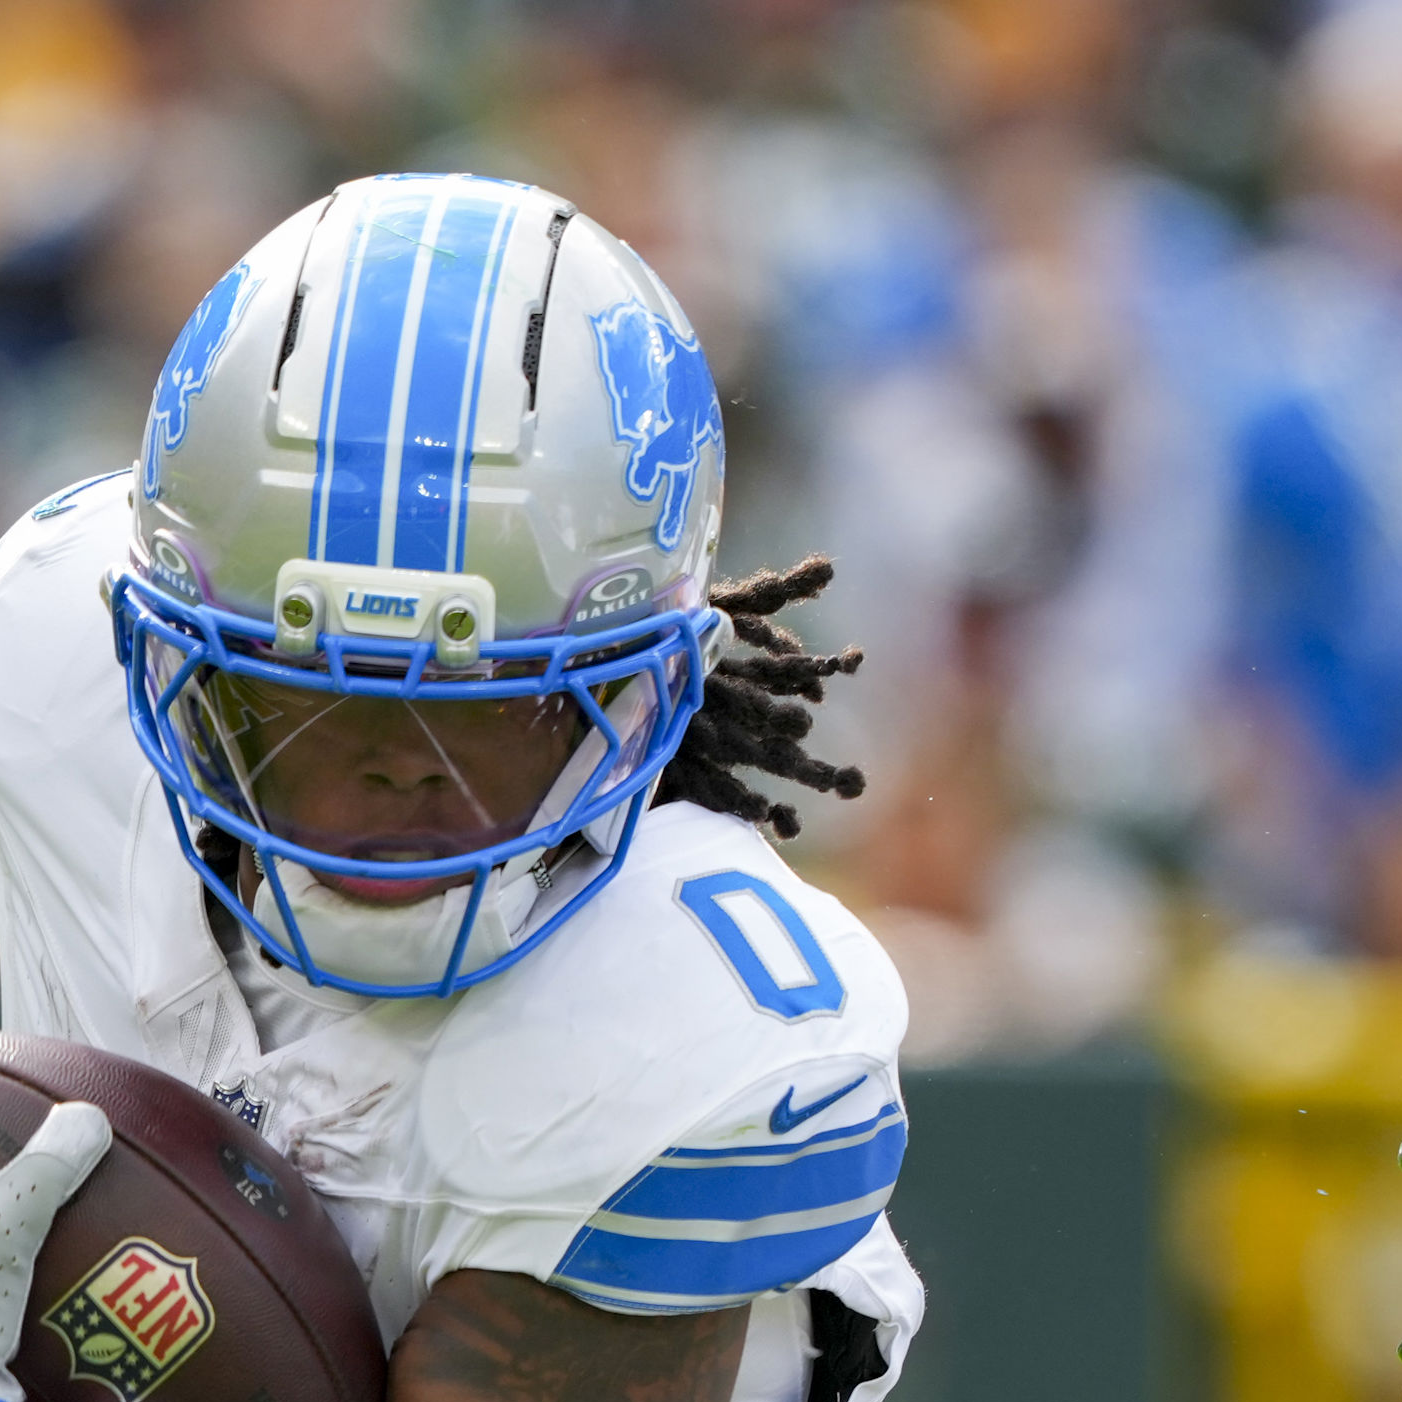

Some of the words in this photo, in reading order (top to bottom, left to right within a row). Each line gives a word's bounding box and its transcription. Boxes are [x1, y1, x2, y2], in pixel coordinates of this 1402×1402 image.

[346, 591, 420, 618] LIONS
[575, 587, 652, 623] OAKLEY
[671, 867, 849, 1026] 0
[101, 1253, 200, 1361] NFL
